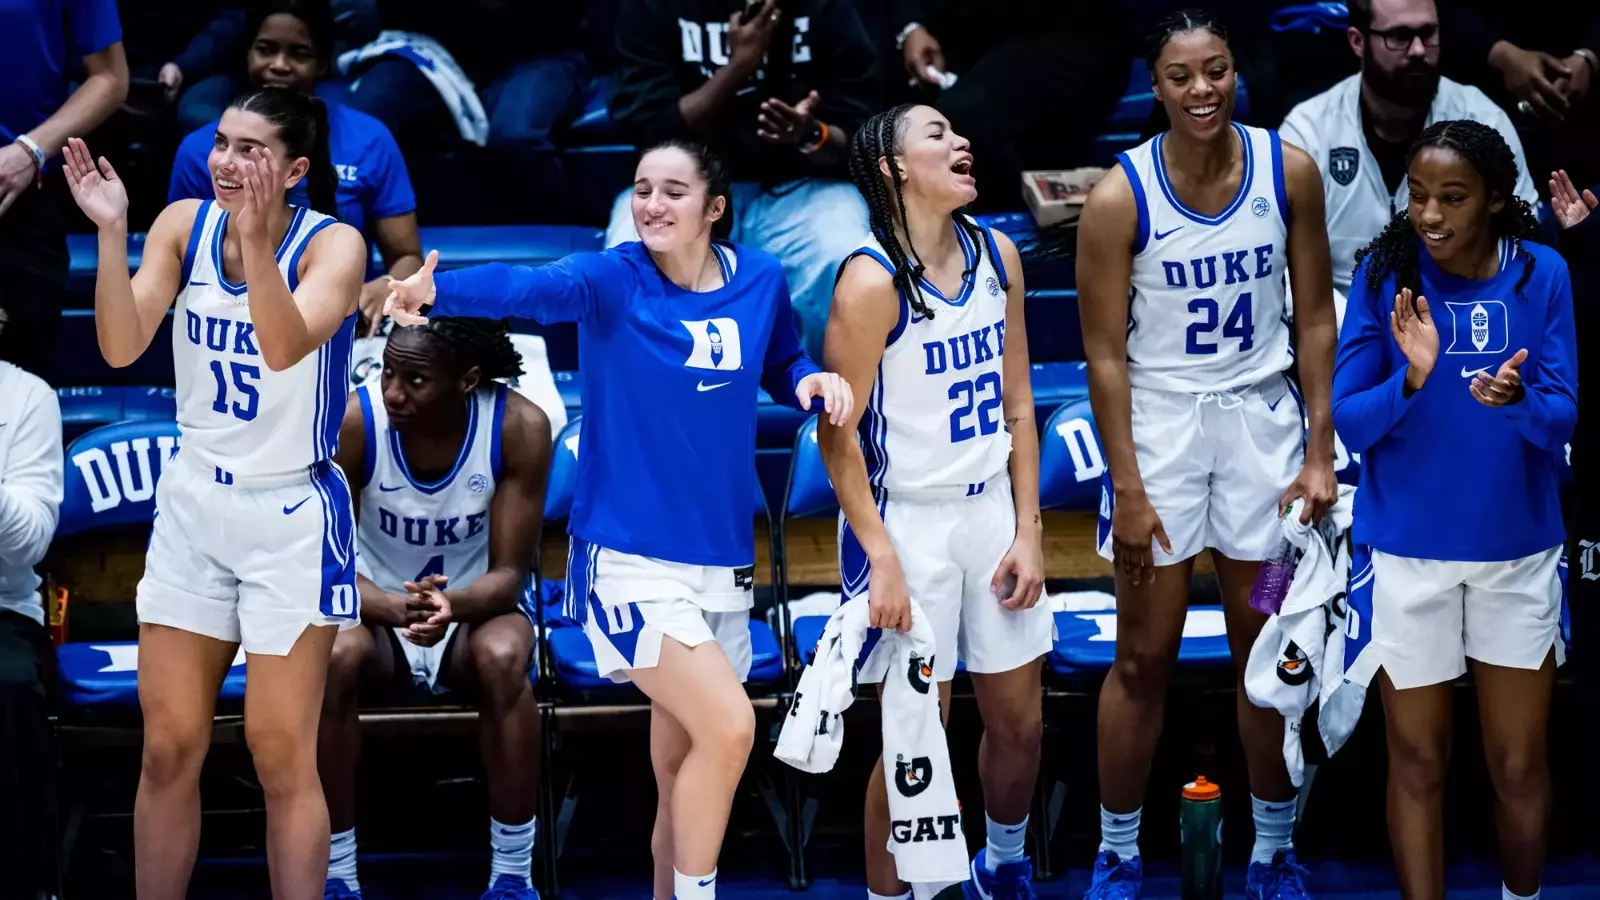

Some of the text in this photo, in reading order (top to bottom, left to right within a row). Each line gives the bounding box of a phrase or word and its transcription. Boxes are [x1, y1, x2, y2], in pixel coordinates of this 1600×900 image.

[678, 16, 812, 66] DUE
[1161, 243, 1274, 289] DUKE
[185, 308, 259, 356] DUK
[1185, 291, 1255, 355] 24
[209, 359, 261, 422] 15
[947, 371, 1003, 443] 22
[72, 436, 182, 513] DU
[378, 506, 487, 547] DUKE
[414, 554, 448, 592] 4
[892, 814, 966, 844] GAT
